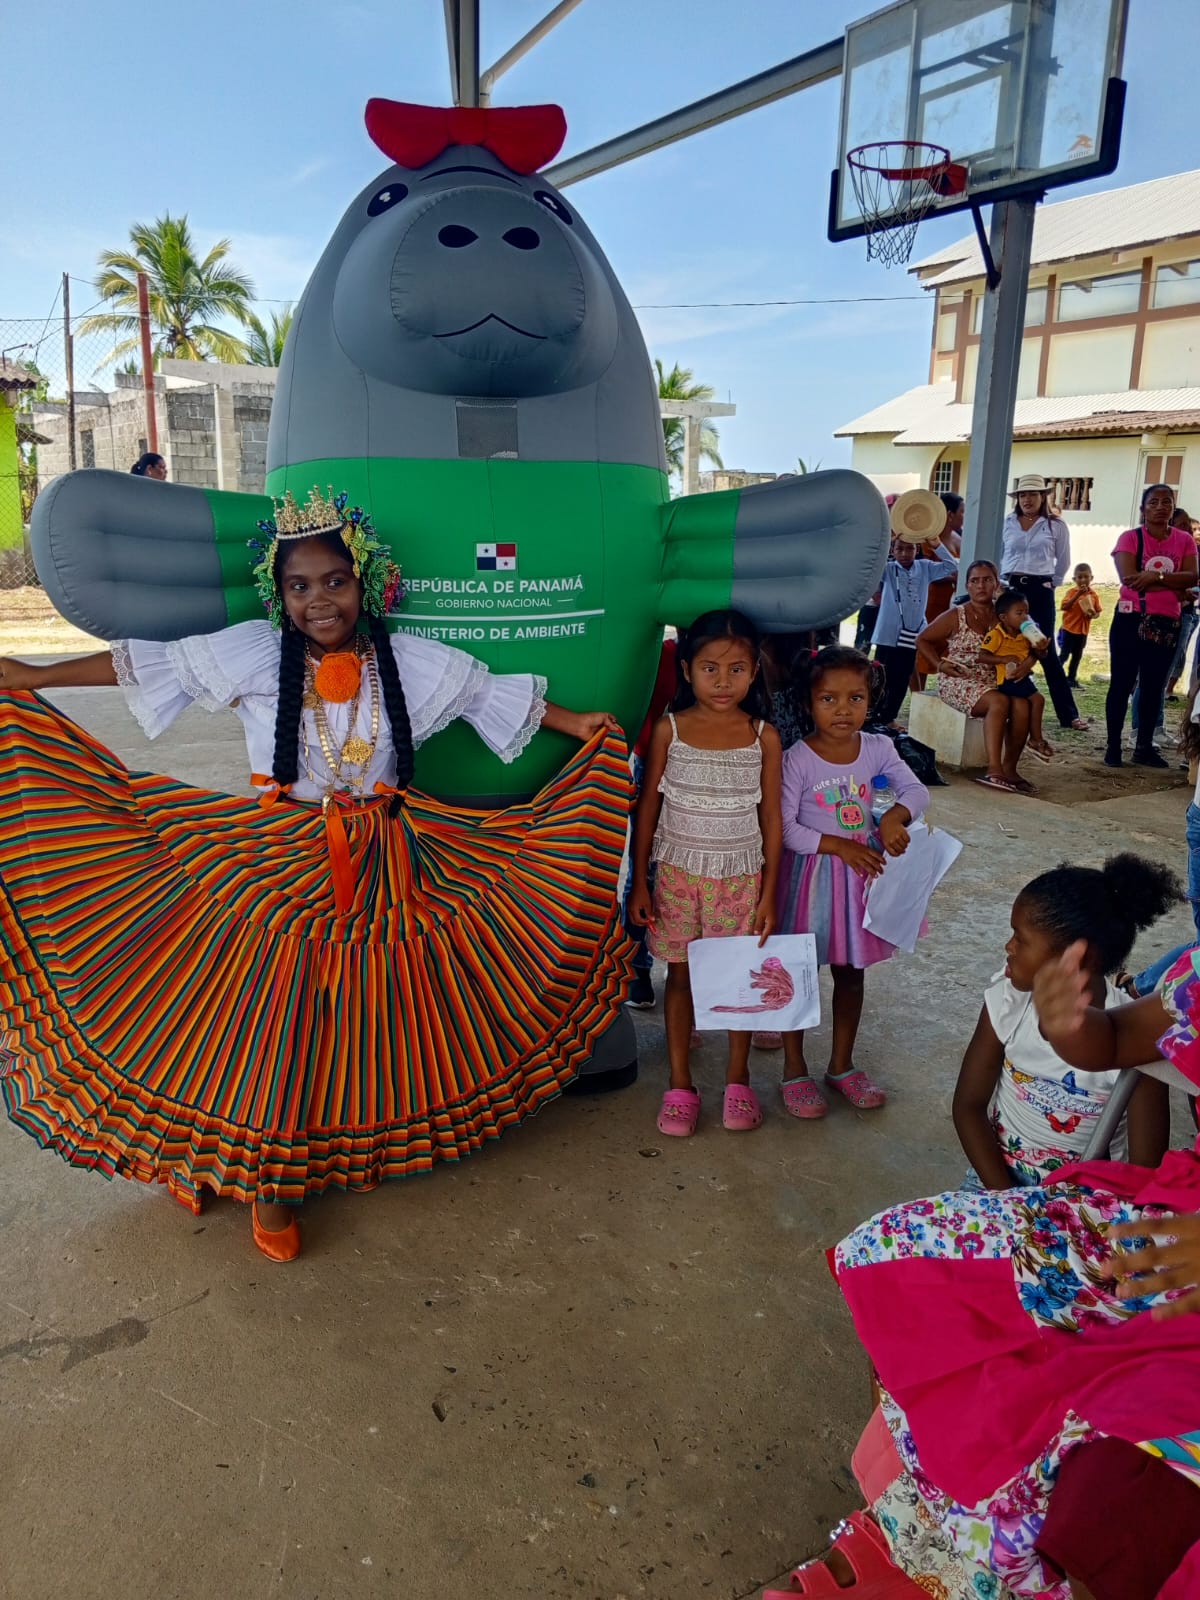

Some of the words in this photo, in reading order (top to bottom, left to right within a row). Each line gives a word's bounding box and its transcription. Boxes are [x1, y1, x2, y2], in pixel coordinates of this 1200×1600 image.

[402, 577, 488, 593] REPÚBLICA
[493, 580, 515, 593] DE
[519, 574, 584, 593] PANAMÁ
[435, 599, 494, 608] GOBIERNO
[497, 598, 552, 609] NACIONAL
[397, 625, 485, 640] MINISTERIO
[489, 627, 510, 640] DE
[514, 622, 586, 639] AMBIENTE
